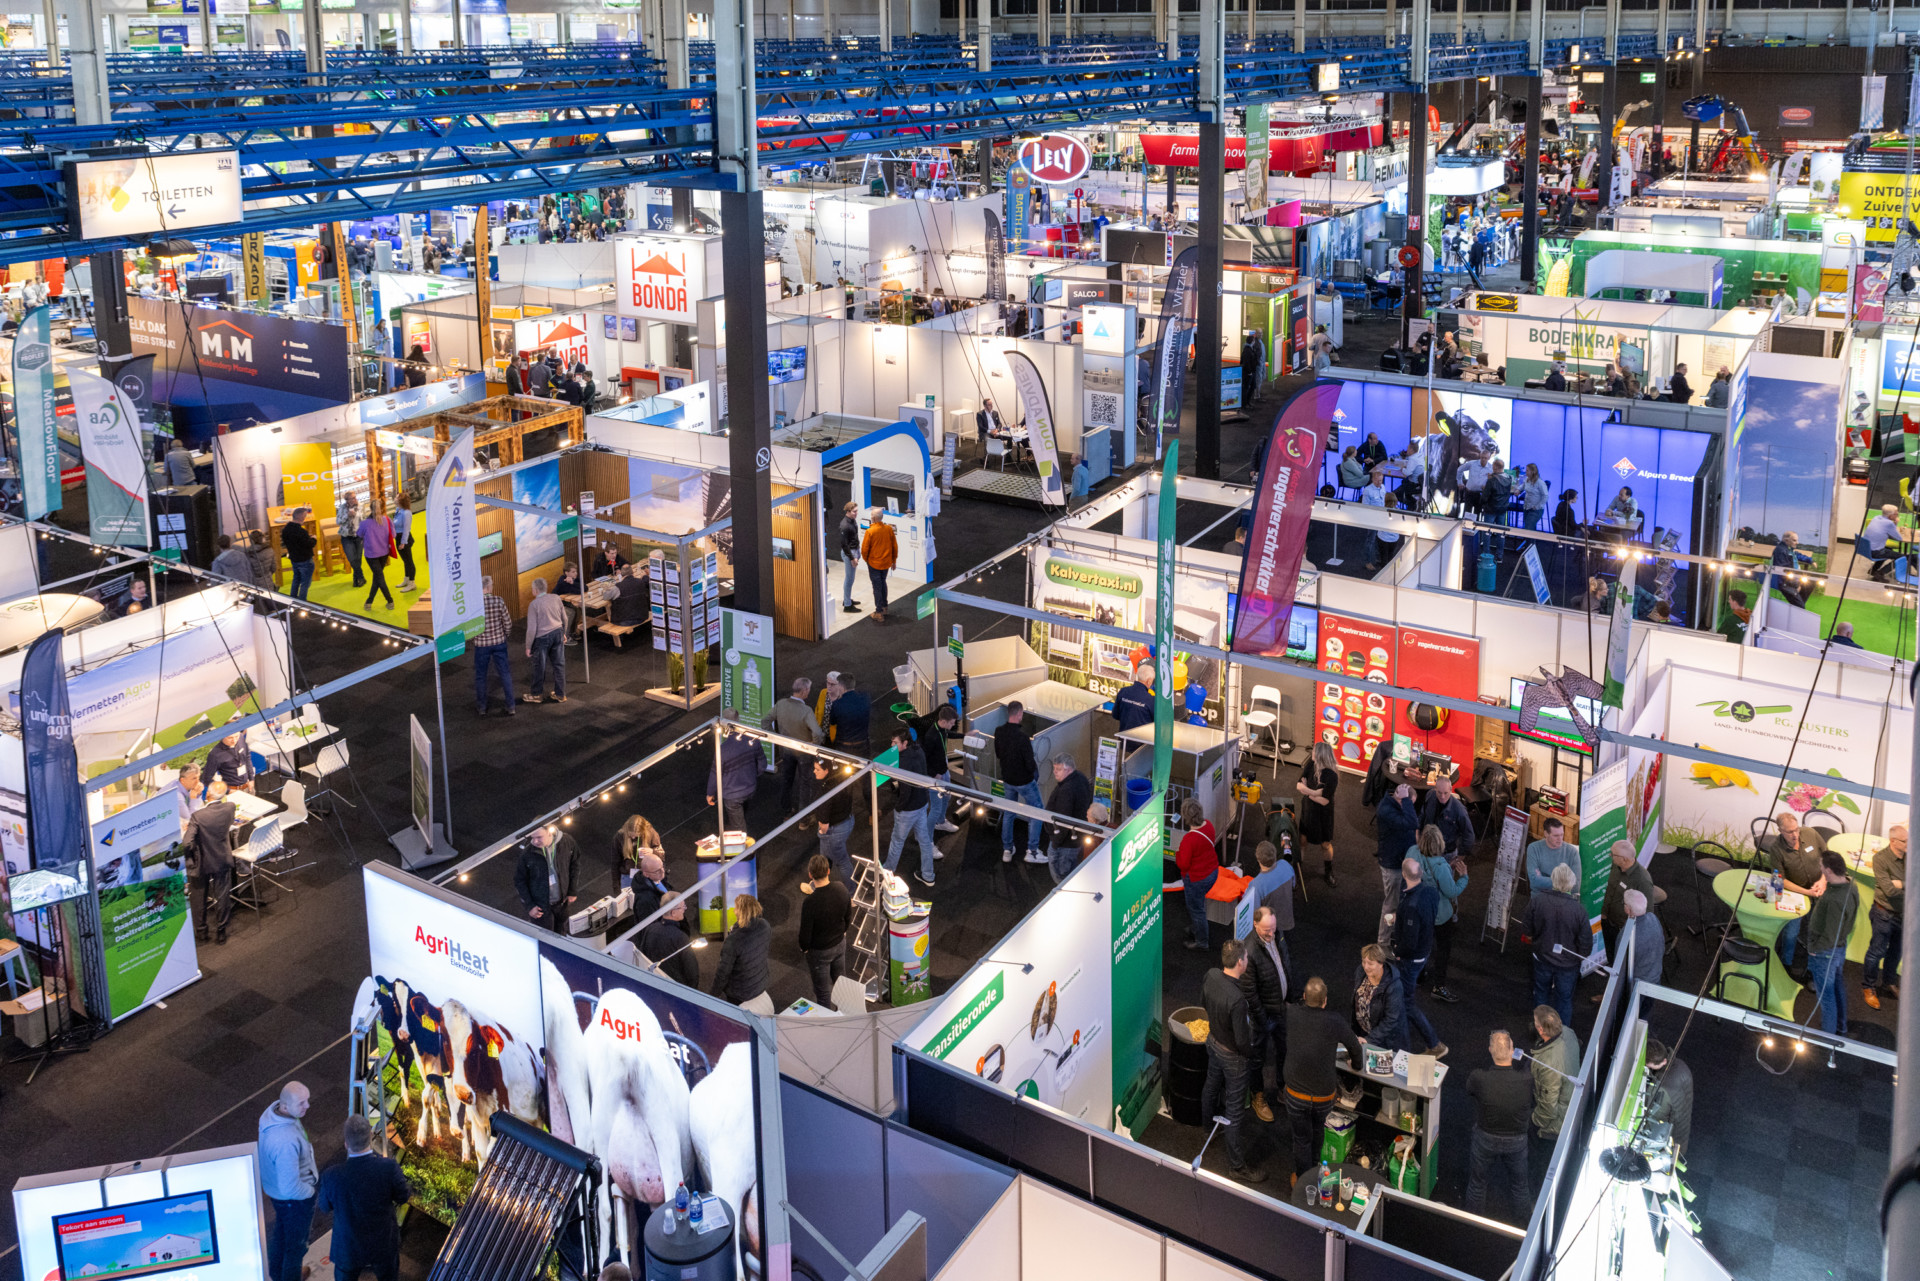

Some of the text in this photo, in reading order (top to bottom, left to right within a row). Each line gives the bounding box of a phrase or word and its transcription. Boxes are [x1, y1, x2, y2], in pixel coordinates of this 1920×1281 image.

[1032, 143, 1074, 174] LELY
[142, 185, 213, 203] TOILETTEN
[1016, 194, 1024, 226] BARTH
[250, 232, 260, 296] ORNADO
[632, 283, 688, 312] BONDA
[1073, 290, 1097, 298] SALCO
[1173, 262, 1188, 308] Witzier
[148, 321, 166, 335] DAK
[1638, 470, 1667, 480] Alpuro
[1050, 564, 1138, 594] Kalvertaxi.nl
[118, 809, 172, 836] VermettenAgro
[1122, 888, 1154, 926] Al 95 jaar
[1114, 894, 1161, 954] producent van
[1114, 910, 1160, 965] mengvoeders
[415, 926, 490, 974] AgriHeat
[450, 957, 486, 979] Elektroboiler
[62, 1224, 84, 1232] Tekort
[98, 1216, 123, 1226] stroom
